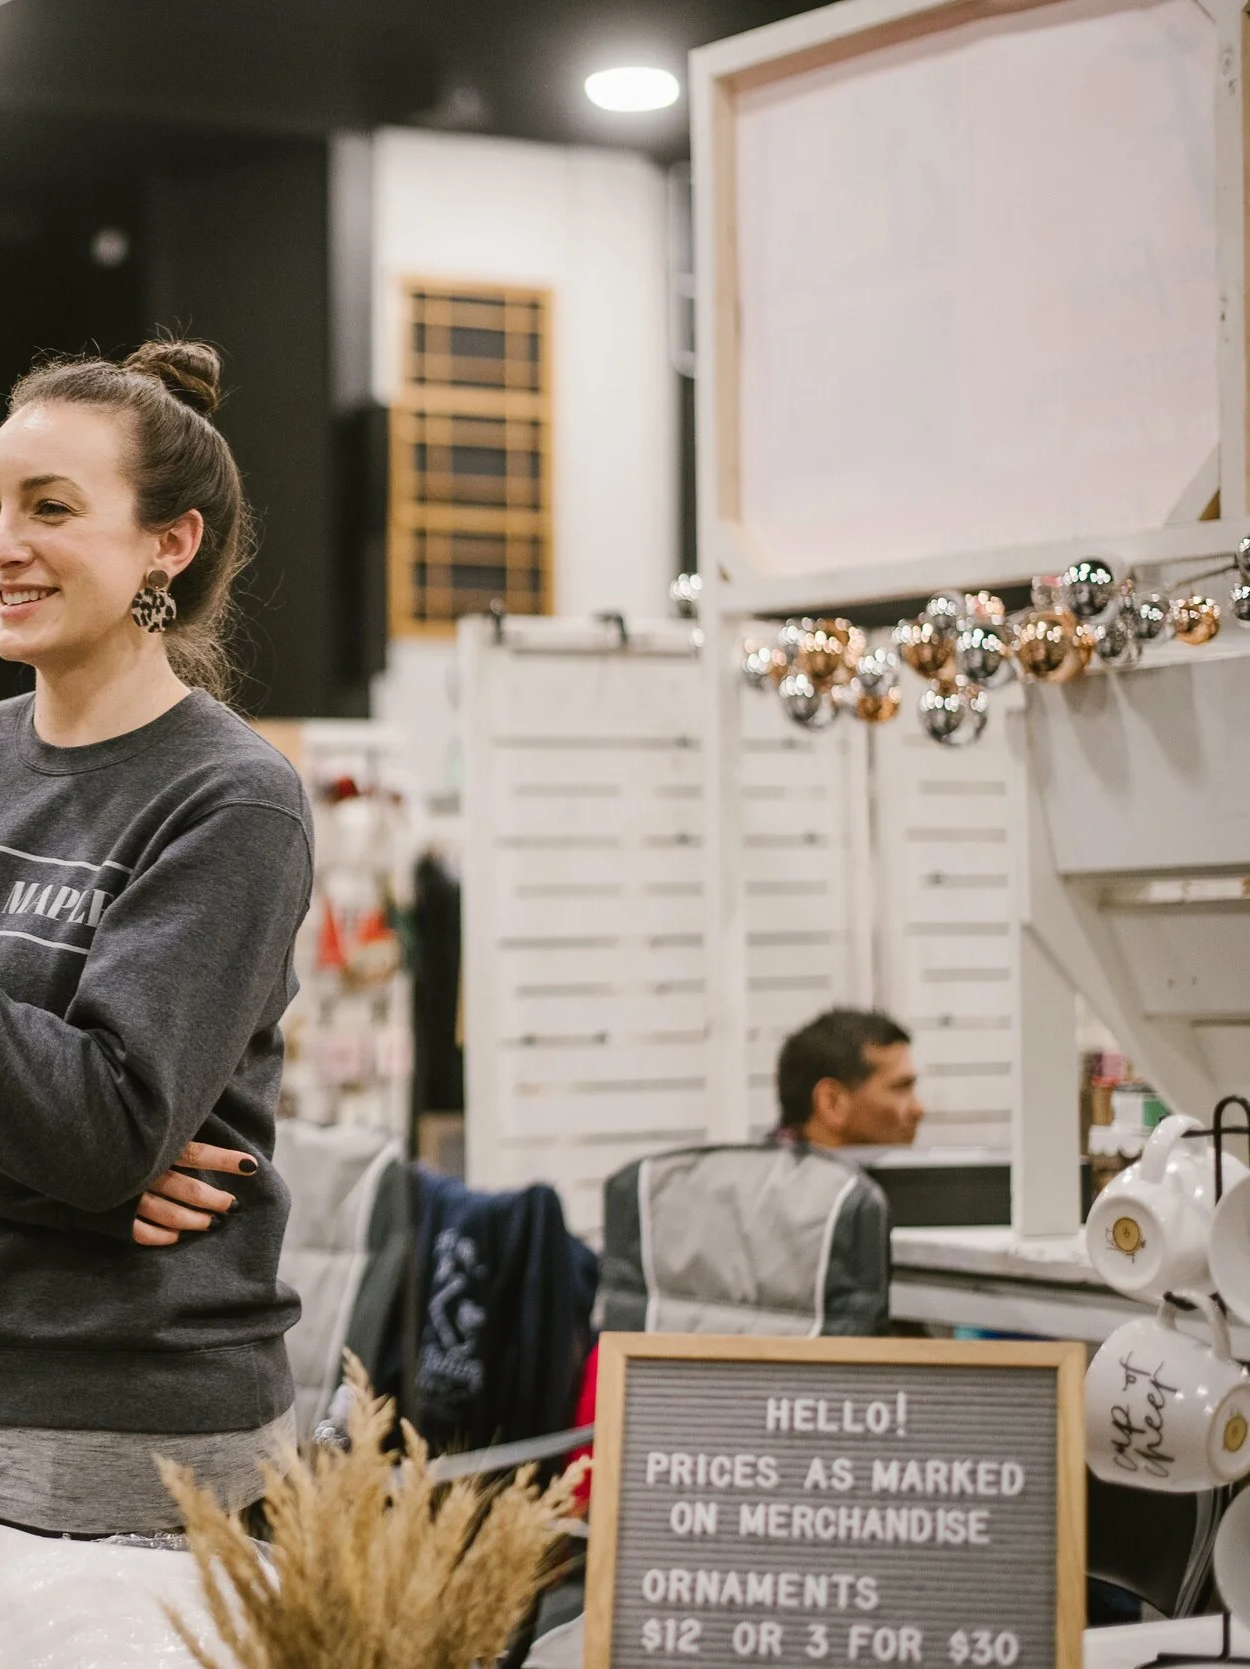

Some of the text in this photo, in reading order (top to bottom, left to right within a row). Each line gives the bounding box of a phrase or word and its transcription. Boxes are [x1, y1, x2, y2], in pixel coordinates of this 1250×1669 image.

[766, 1391, 906, 1437] HELLO!
[1110, 1350, 1152, 1472] cup of
[1134, 1360, 1179, 1478] cheer
[647, 1452, 1025, 1496] PRICES AS MARKED
[670, 1501, 992, 1544] ON MERCHANDISE
[642, 1568, 880, 1611] ORNAMENTS
[642, 1618, 1020, 1666] $12 OR 3 FOR $30
